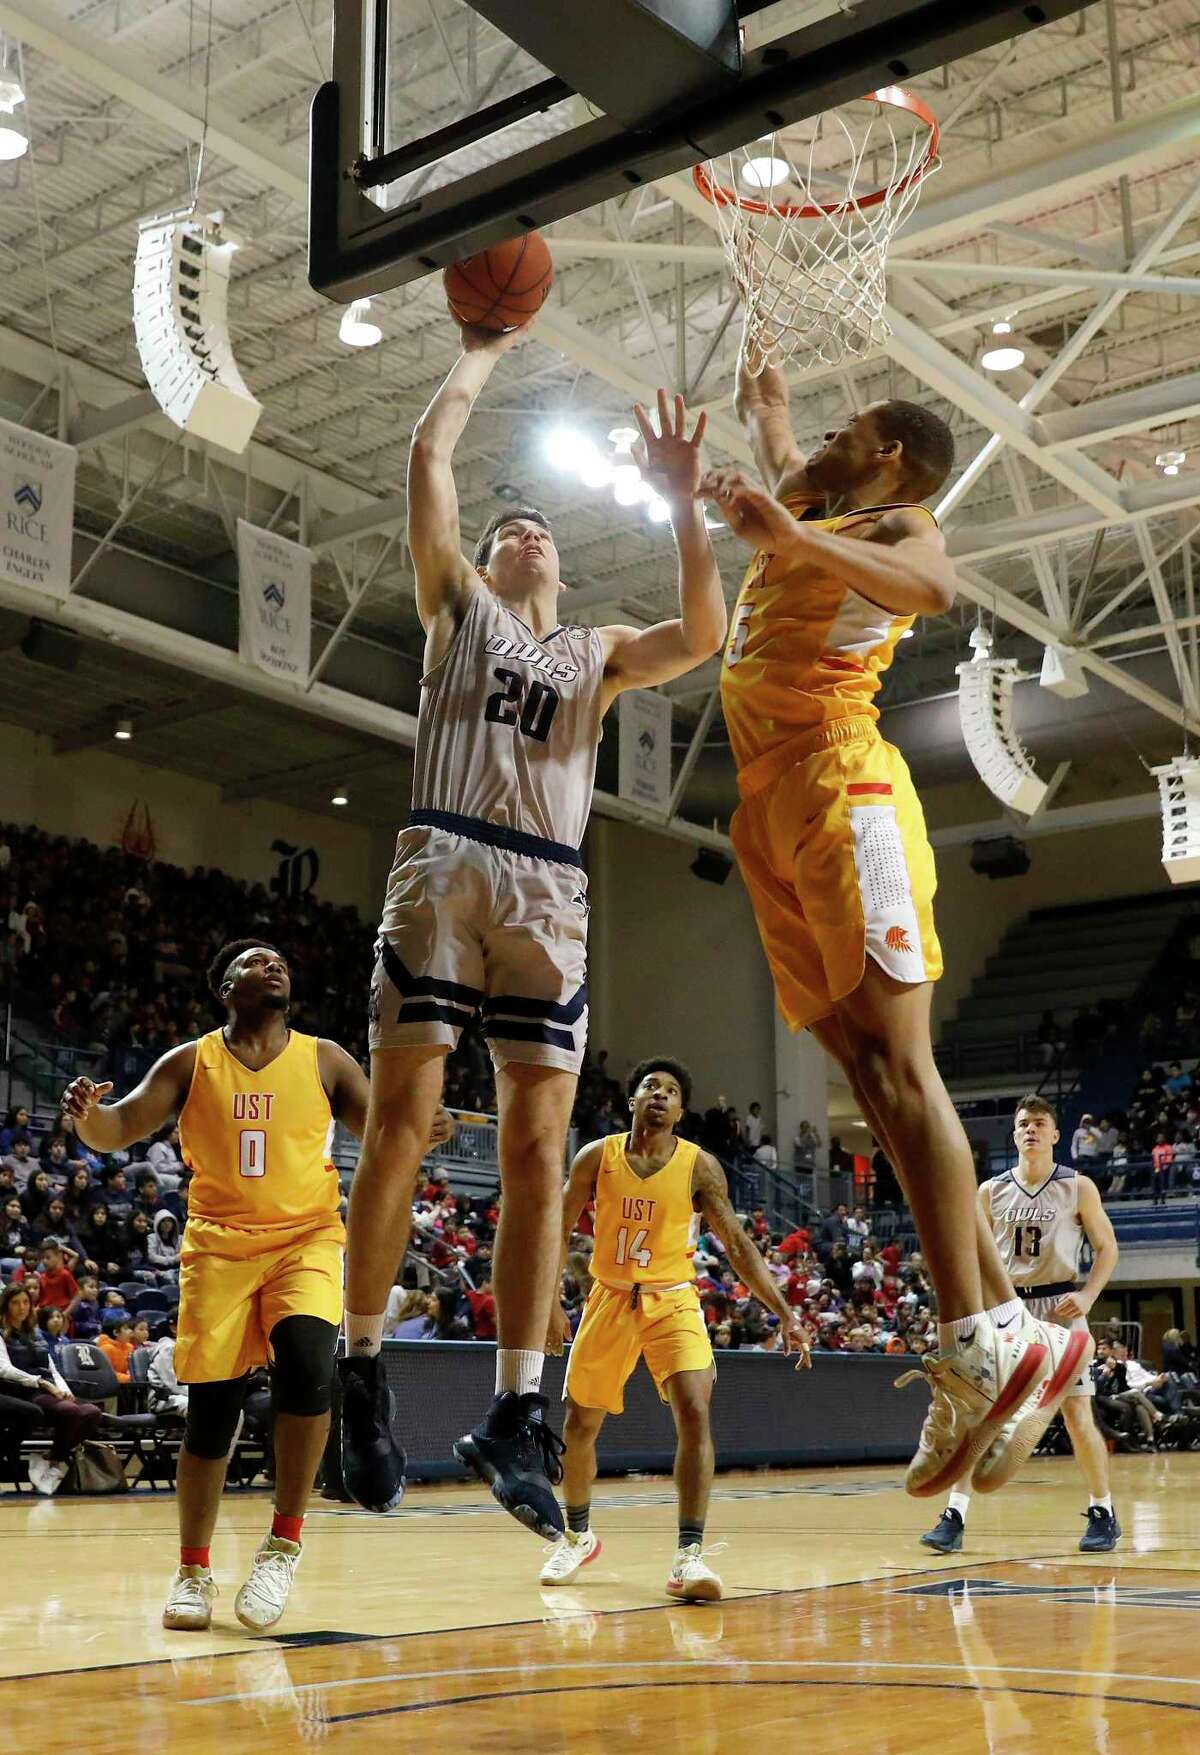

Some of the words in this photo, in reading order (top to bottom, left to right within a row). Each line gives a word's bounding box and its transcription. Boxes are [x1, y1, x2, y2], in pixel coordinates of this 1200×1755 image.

[7, 511, 49, 544] RICE
[484, 634, 580, 682] OWLS
[484, 667, 560, 742] 20
[232, 1093, 275, 1121] UST
[239, 1128, 267, 1178] 0
[621, 1196, 658, 1223] UST
[1004, 1206, 1056, 1223] OWLS
[615, 1225, 654, 1268] 14
[1014, 1226, 1043, 1258] 13
